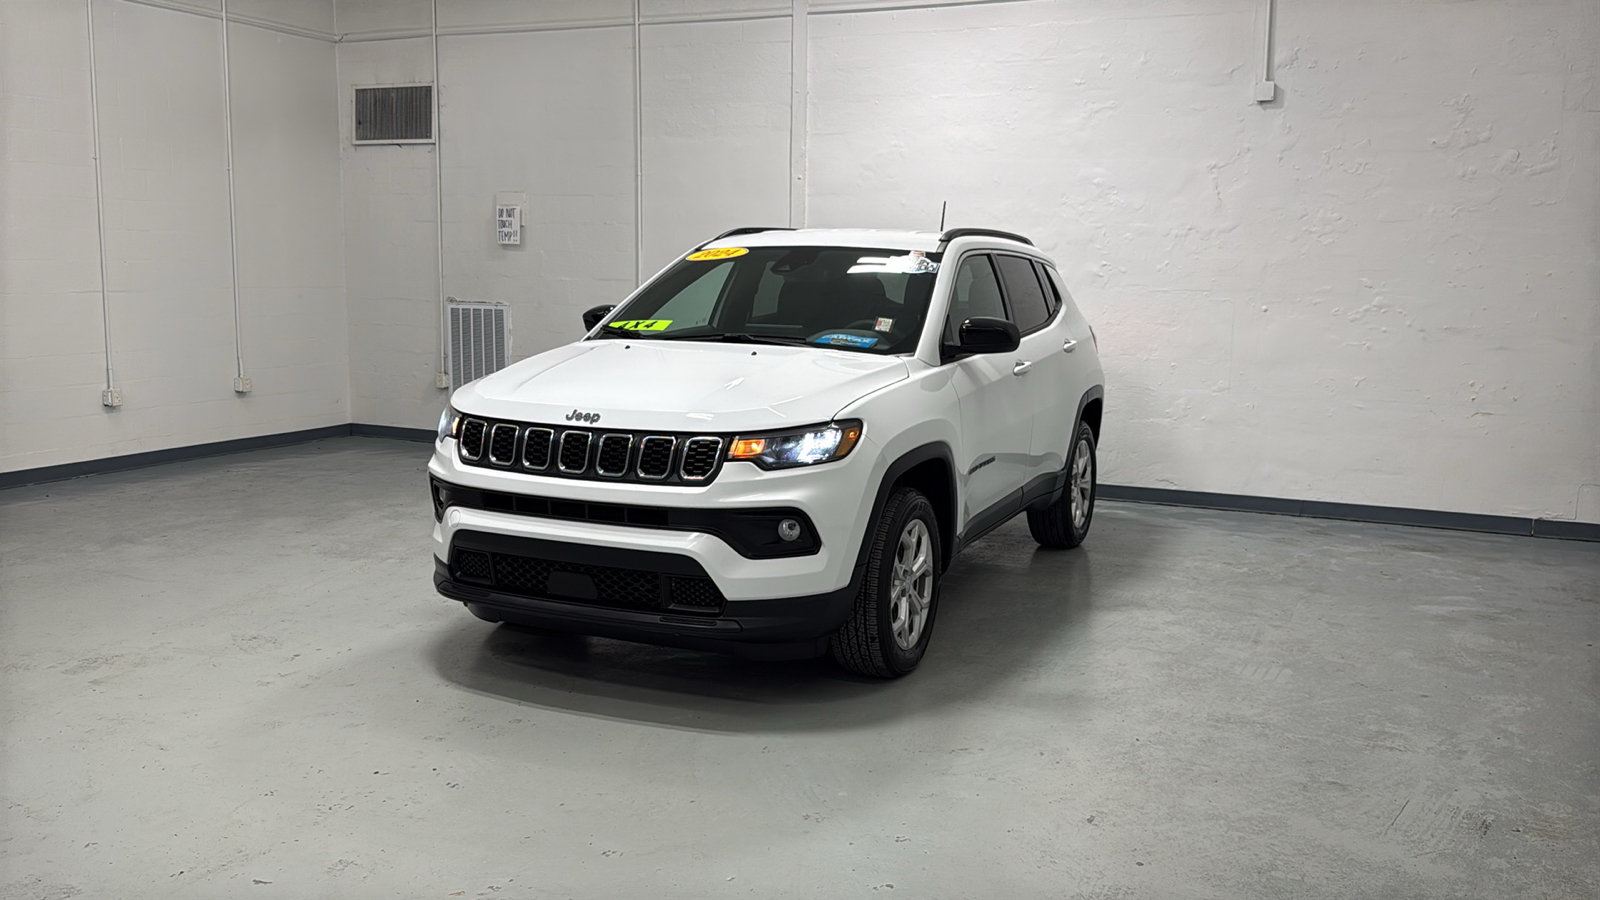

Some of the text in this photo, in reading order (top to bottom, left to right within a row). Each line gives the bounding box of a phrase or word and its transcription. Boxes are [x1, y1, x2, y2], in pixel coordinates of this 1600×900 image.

[498, 208, 517, 219] DO NOT
[498, 219, 513, 229] TOUCH
[498, 230, 518, 242] TEMP!!
[565, 409, 601, 425] Jeep
